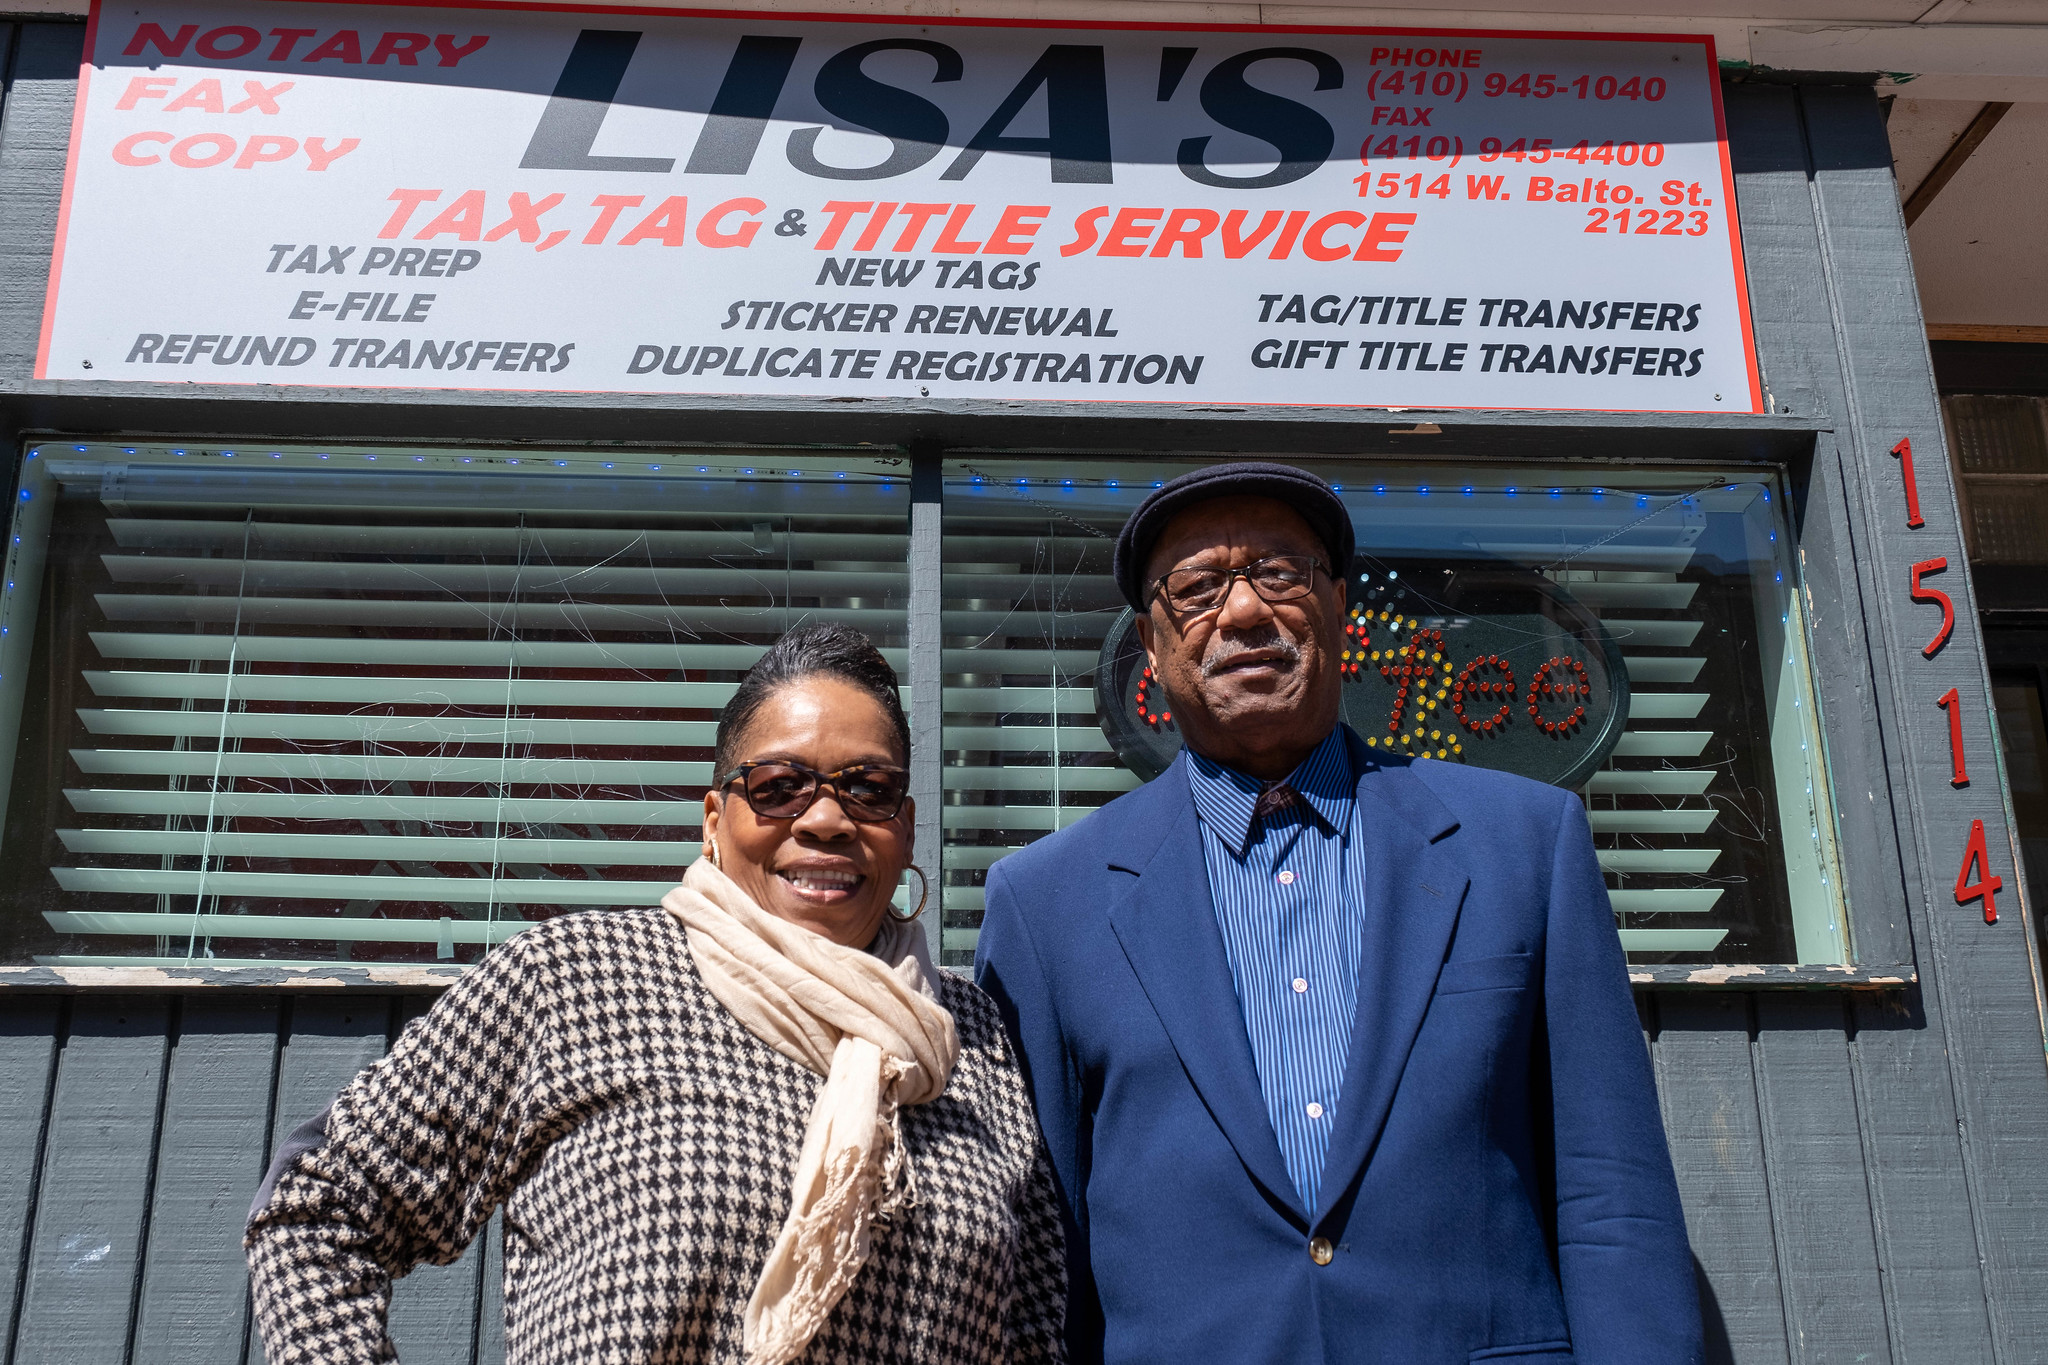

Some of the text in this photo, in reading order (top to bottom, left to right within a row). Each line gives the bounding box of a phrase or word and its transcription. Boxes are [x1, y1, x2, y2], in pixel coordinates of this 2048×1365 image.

[121, 22, 490, 68] NOTARY
[1368, 47, 1483, 69] PHONE
[114, 76, 296, 115] FAX
[1366, 69, 1667, 103] (410) 945-1040
[518, 29, 1344, 190] LISA'S
[1370, 106, 1435, 127] FAX
[111, 131, 361, 172] COPY
[1359, 134, 1665, 168] (410) 945-4400
[1352, 171, 1713, 207] 1514 W. Balto. St.
[773, 208, 808, 238] &
[813, 200, 1052, 256] TITLE
[1059, 205, 1418, 263] SERVICE
[1584, 207, 1709, 237] 21223
[265, 243, 482, 278] TAX PREP
[814, 256, 1041, 291] NEW TAGS
[287, 290, 437, 323] E-FILE
[720, 299, 1119, 338] STICKER RENEWAL
[1257, 293, 1702, 333] TAG/TITLE TRANSFERS
[124, 333, 576, 374] REFUND TRANSFERS
[626, 344, 1205, 385] DUPLICATE REGISTRATION
[1250, 338, 1705, 378] GIFT TITLE TRANSFERS
[1889, 436, 2002, 924] 1514
